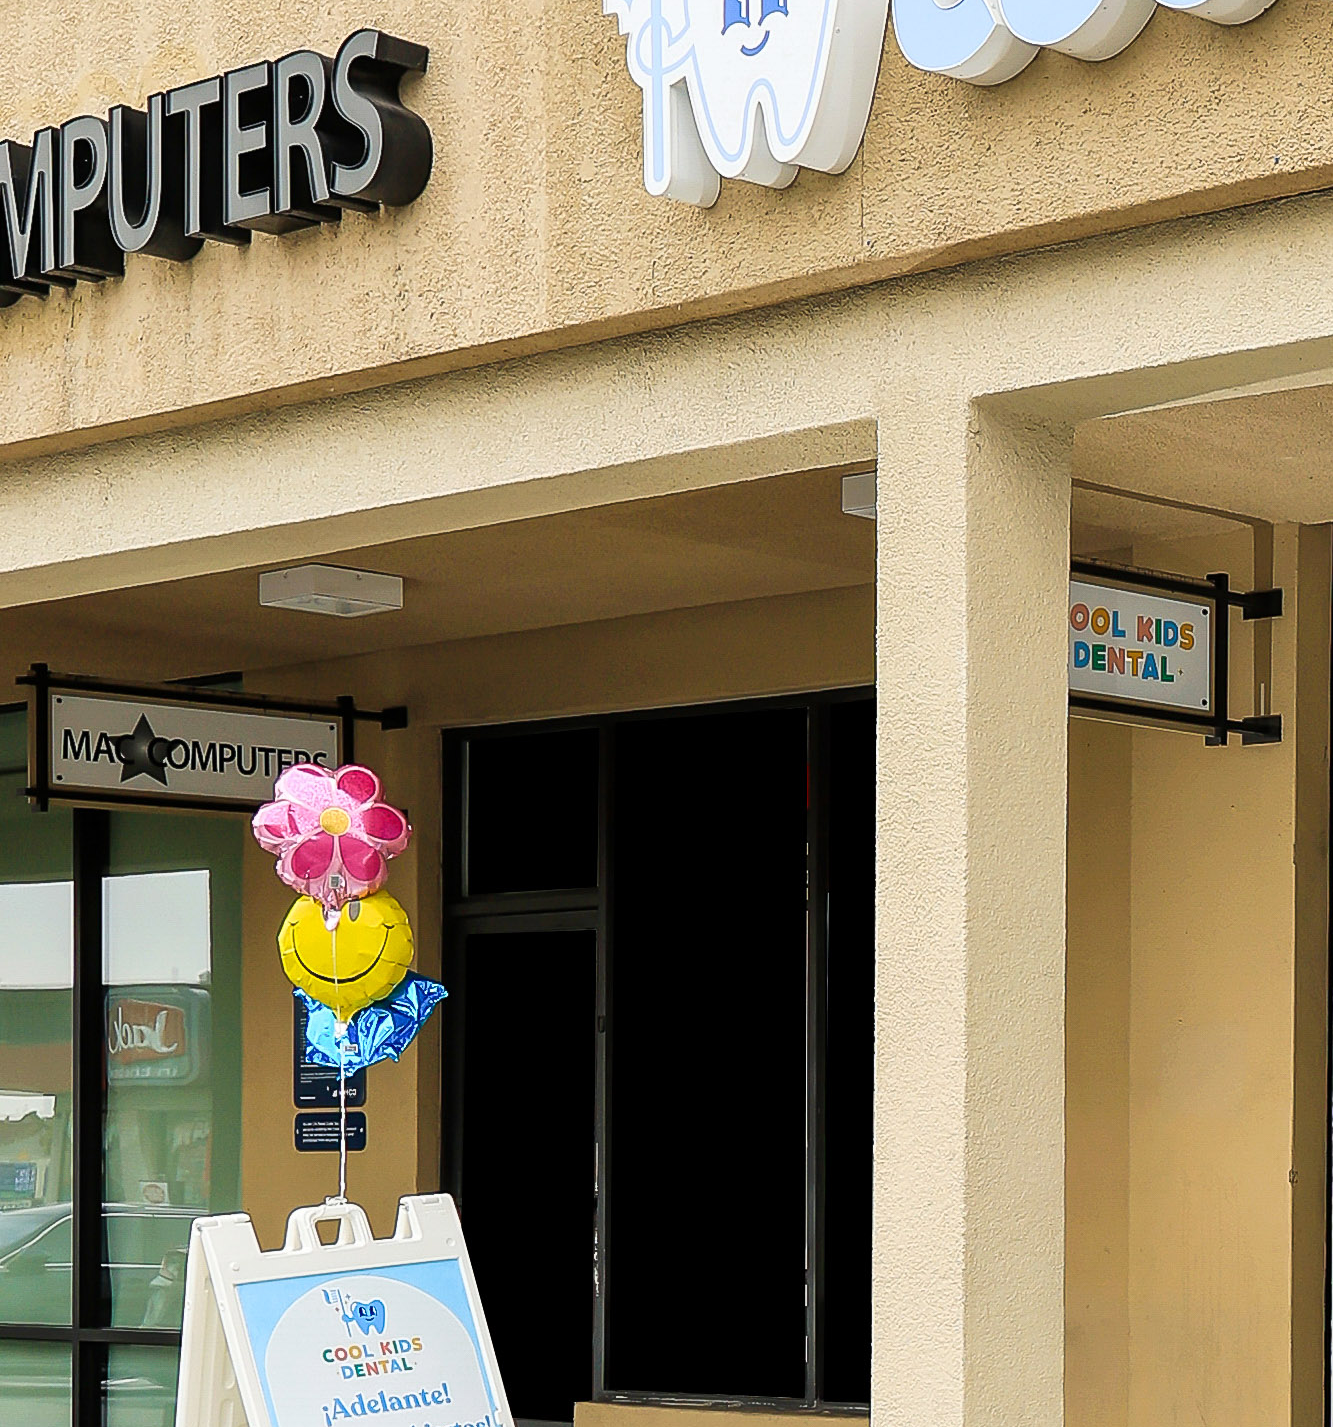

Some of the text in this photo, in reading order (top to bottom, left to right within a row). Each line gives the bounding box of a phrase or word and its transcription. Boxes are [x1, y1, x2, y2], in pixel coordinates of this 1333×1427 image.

[1136, 615, 1195, 651] KIDS
[1074, 640, 1174, 682] DENTAL
[62, 727, 135, 765] MAC
[322, 1337, 423, 1362] COOL KIDS
[340, 1358, 413, 1379] DENTAL
[322, 1382, 451, 1427] ¡Adelante!
